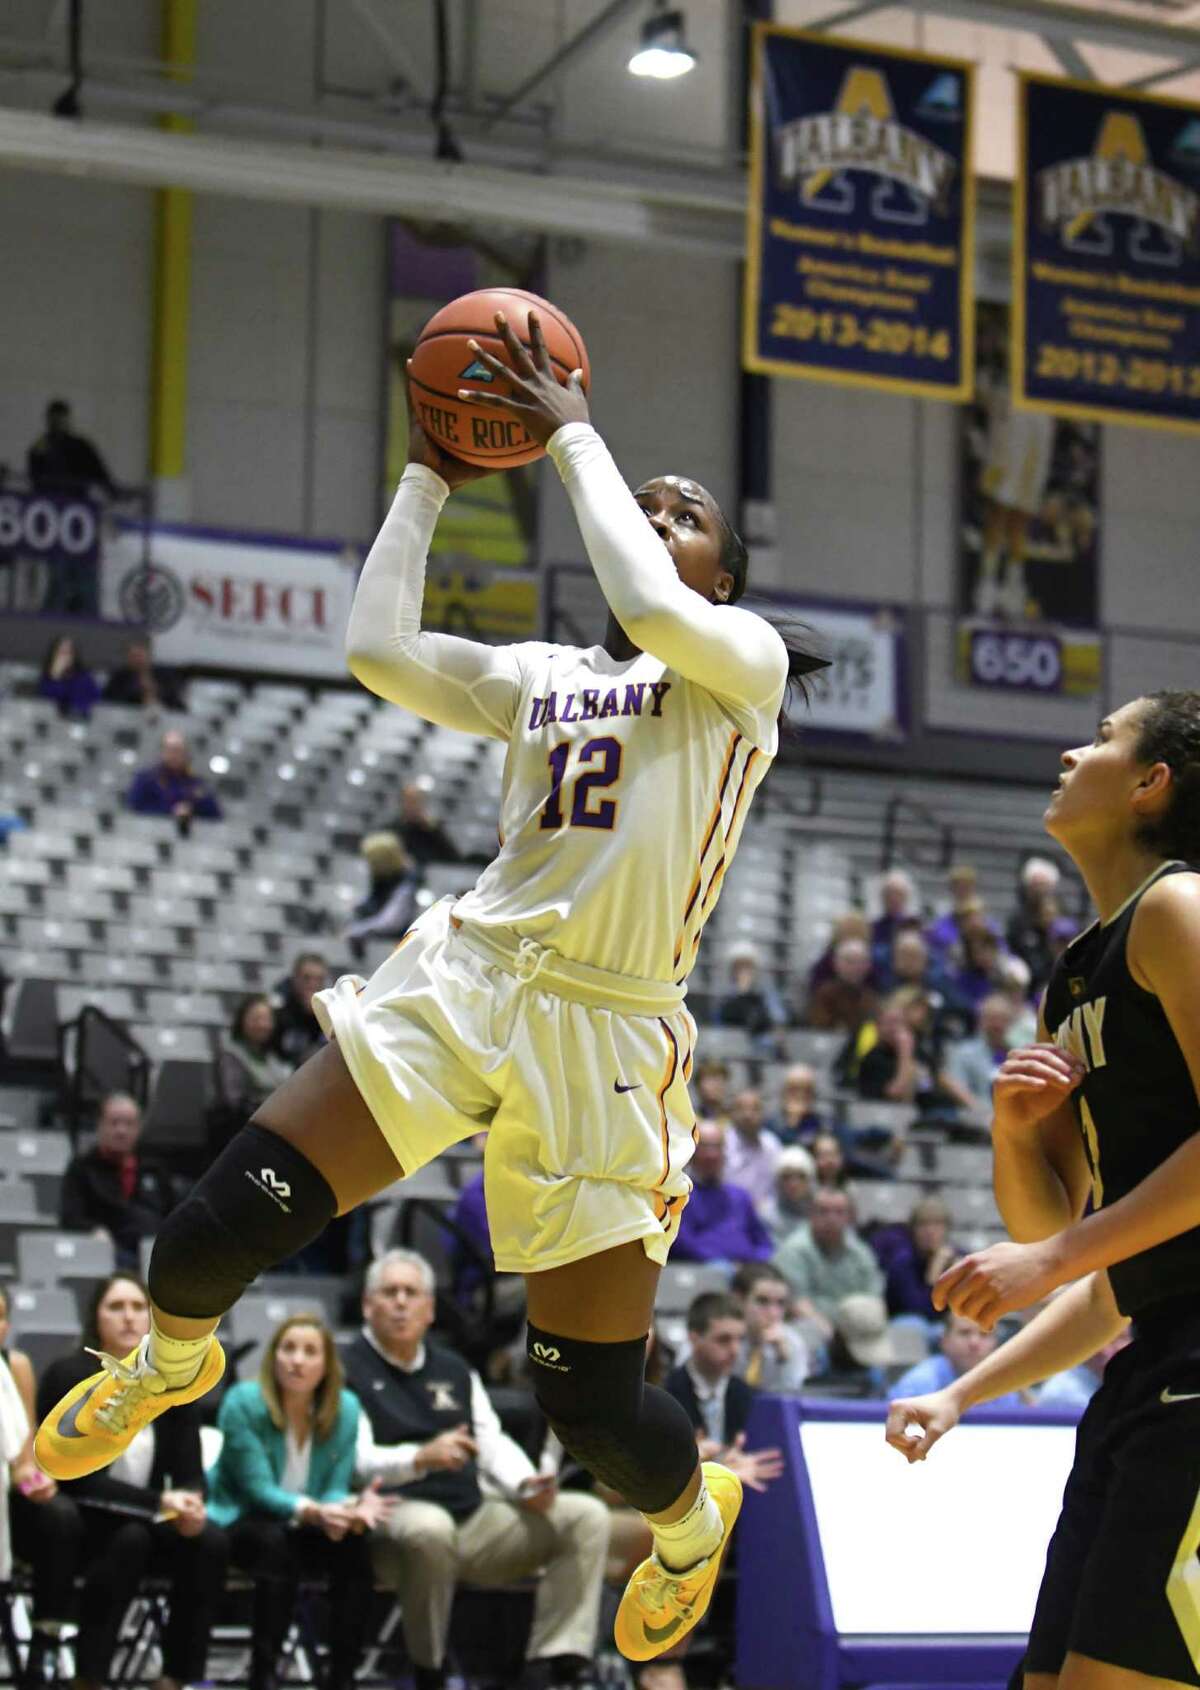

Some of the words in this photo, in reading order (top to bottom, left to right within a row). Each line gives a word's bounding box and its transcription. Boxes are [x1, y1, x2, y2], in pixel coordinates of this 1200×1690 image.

[419, 402, 459, 445] THE
[972, 635, 1060, 686] 650
[528, 682, 671, 731] UALBANY
[540, 736, 622, 832] 12
